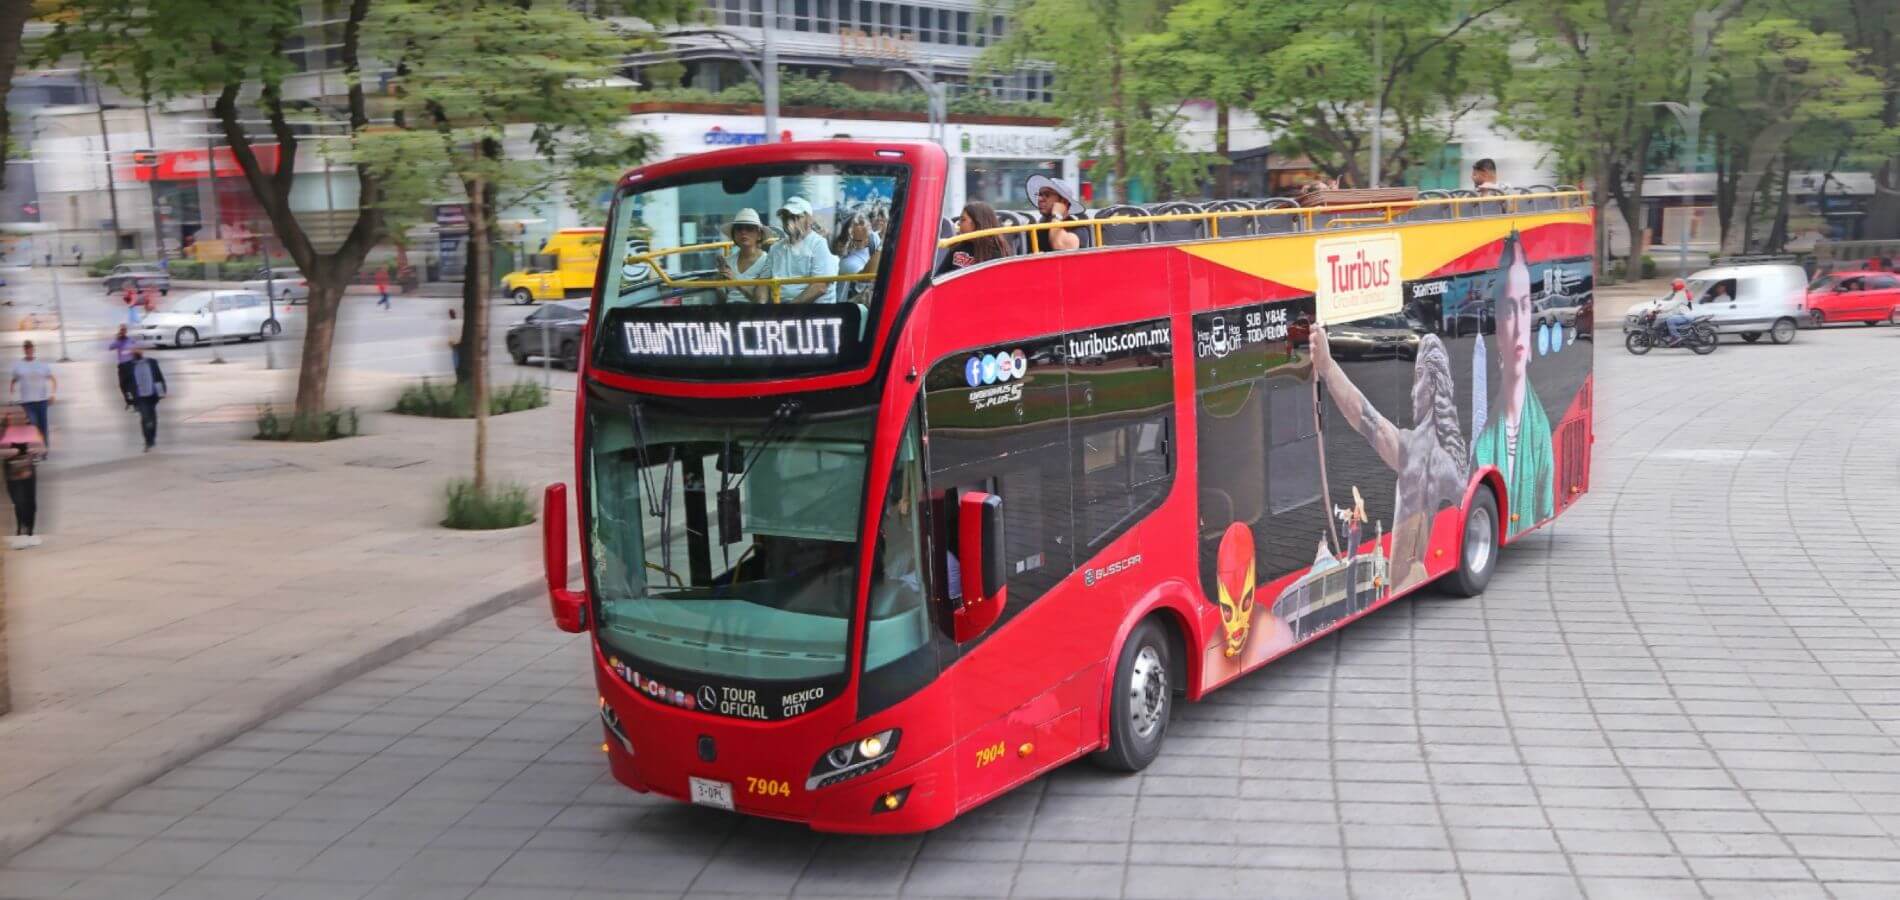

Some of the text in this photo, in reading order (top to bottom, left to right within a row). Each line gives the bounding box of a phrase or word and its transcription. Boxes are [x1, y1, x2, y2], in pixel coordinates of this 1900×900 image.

[1327, 248, 1390, 294] Turibus
[623, 317, 843, 356] DOWNTOWN CIRCUIT
[1069, 327, 1171, 359] turibus.com.mx
[1197, 341, 1212, 358] On
[1095, 554, 1141, 580] BUSSCAR
[721, 686, 757, 704] TOUR
[781, 687, 824, 706] MEXICO
[720, 700, 769, 720] OFICIAL
[783, 703, 808, 717] CITY
[976, 740, 1006, 769] 7904
[746, 776, 791, 797] 7904
